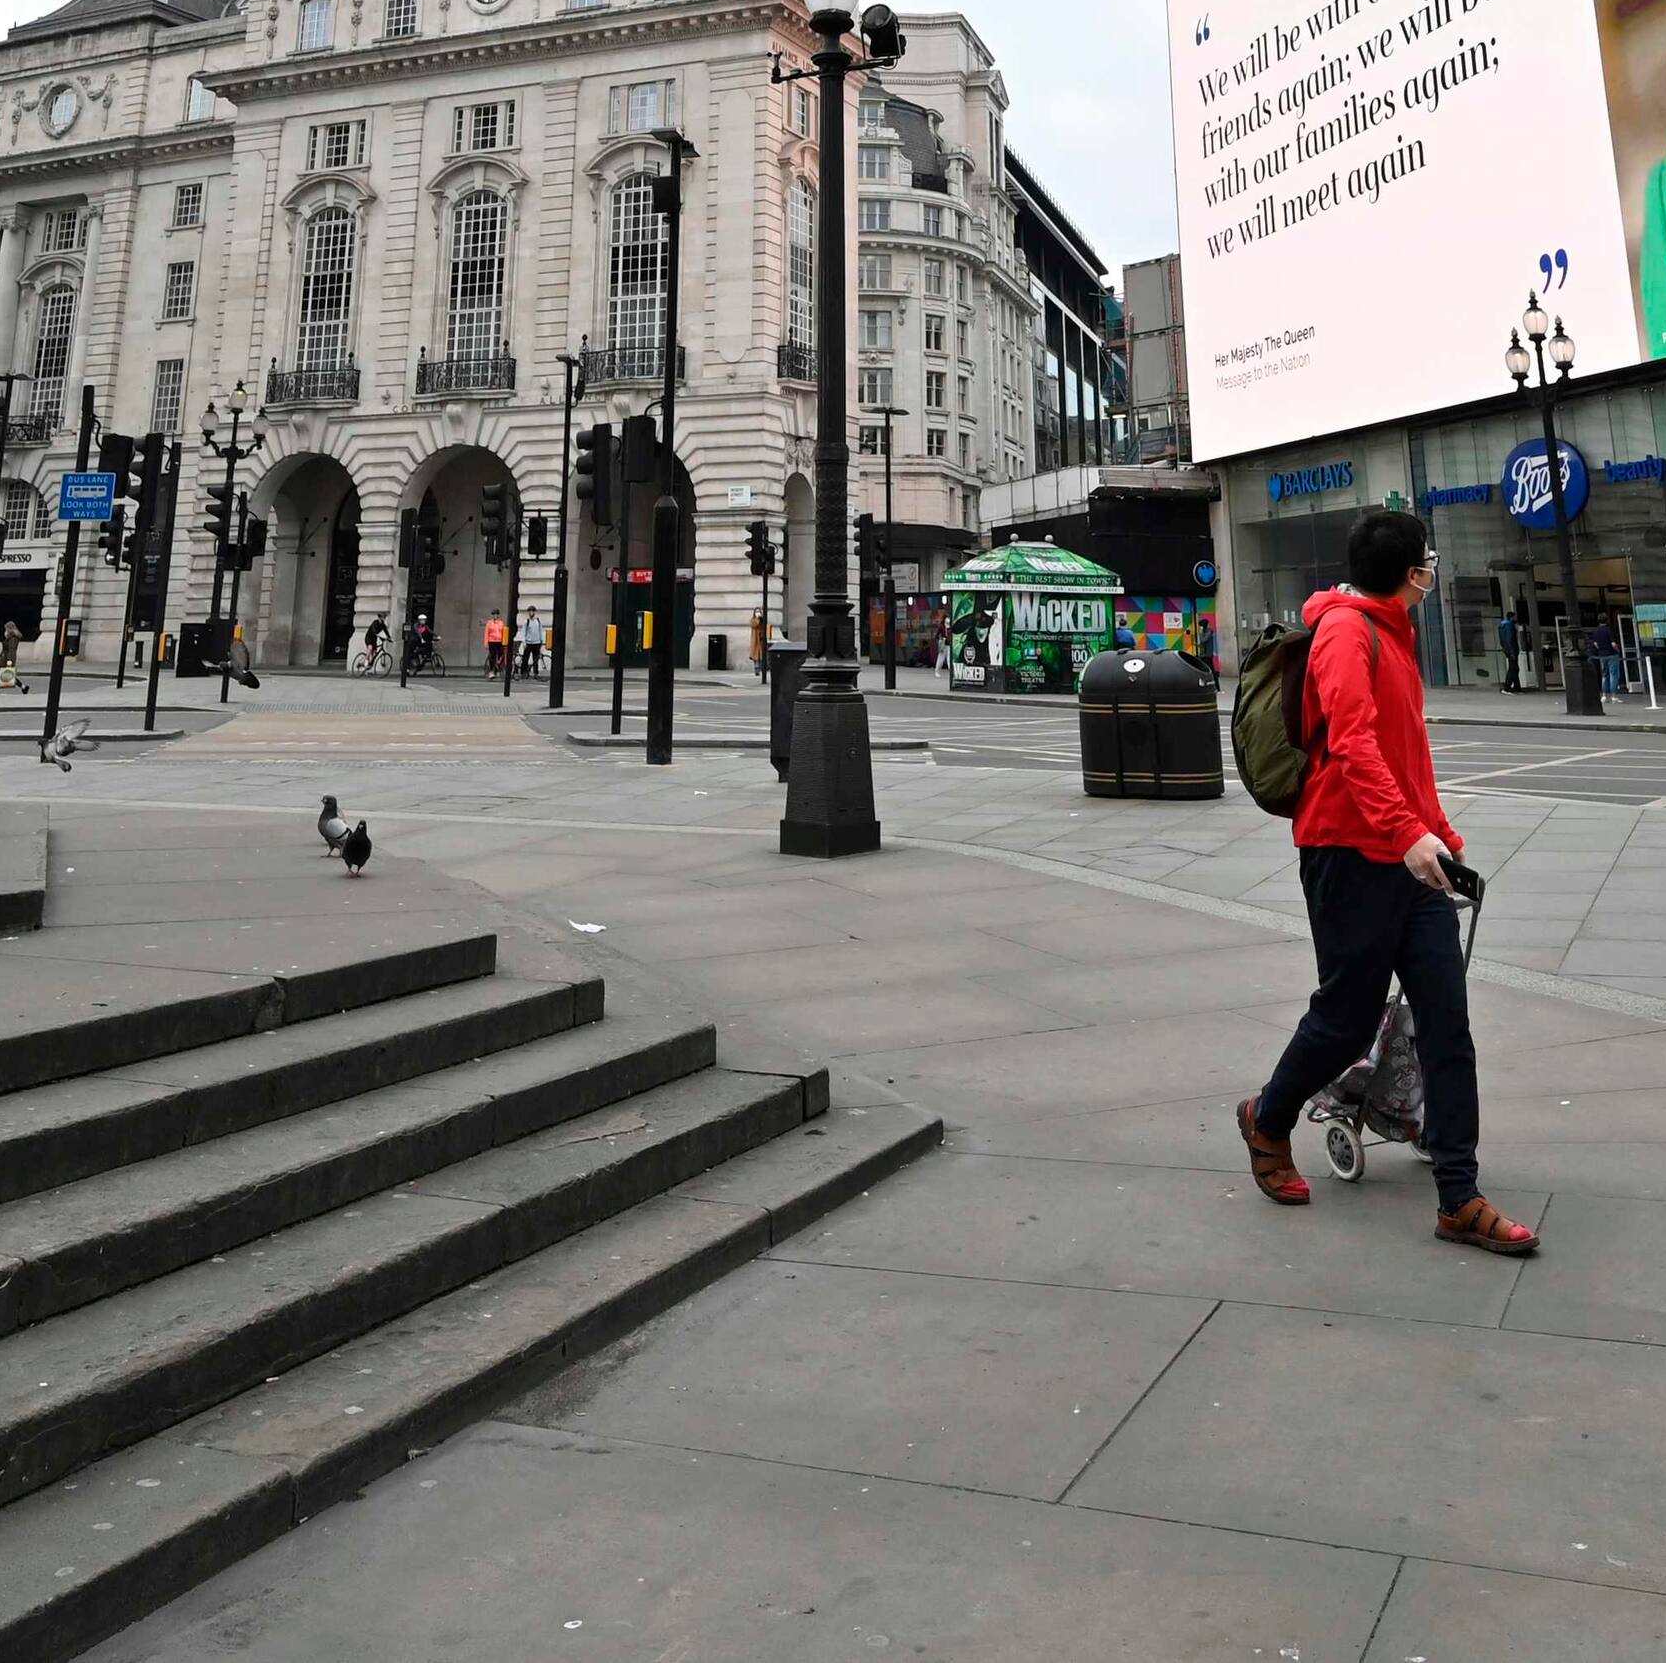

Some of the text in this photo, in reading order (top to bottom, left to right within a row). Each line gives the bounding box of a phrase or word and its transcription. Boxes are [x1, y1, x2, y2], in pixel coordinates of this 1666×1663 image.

[1198, 68, 1229, 107] We
[1232, 33, 1270, 87] will
[1273, 25, 1302, 62] be
[1201, 92, 1273, 159] friends
[1278, 54, 1352, 119] again;
[1356, 28, 1395, 70] we
[1204, 37, 1499, 208] with our families again;
[1207, 134, 1427, 260] we will meet again
[1214, 325, 1315, 368] Her Majesty The Queen
[1216, 353, 1311, 391] Message to the Nation
[1284, 461, 1354, 497] BARCLAYS
[1510, 450, 1571, 515] Boos
[1604, 454, 1665, 484] beauty
[1424, 485, 1490, 512] pharmacy
[1053, 576, 1074, 584] SHOW
